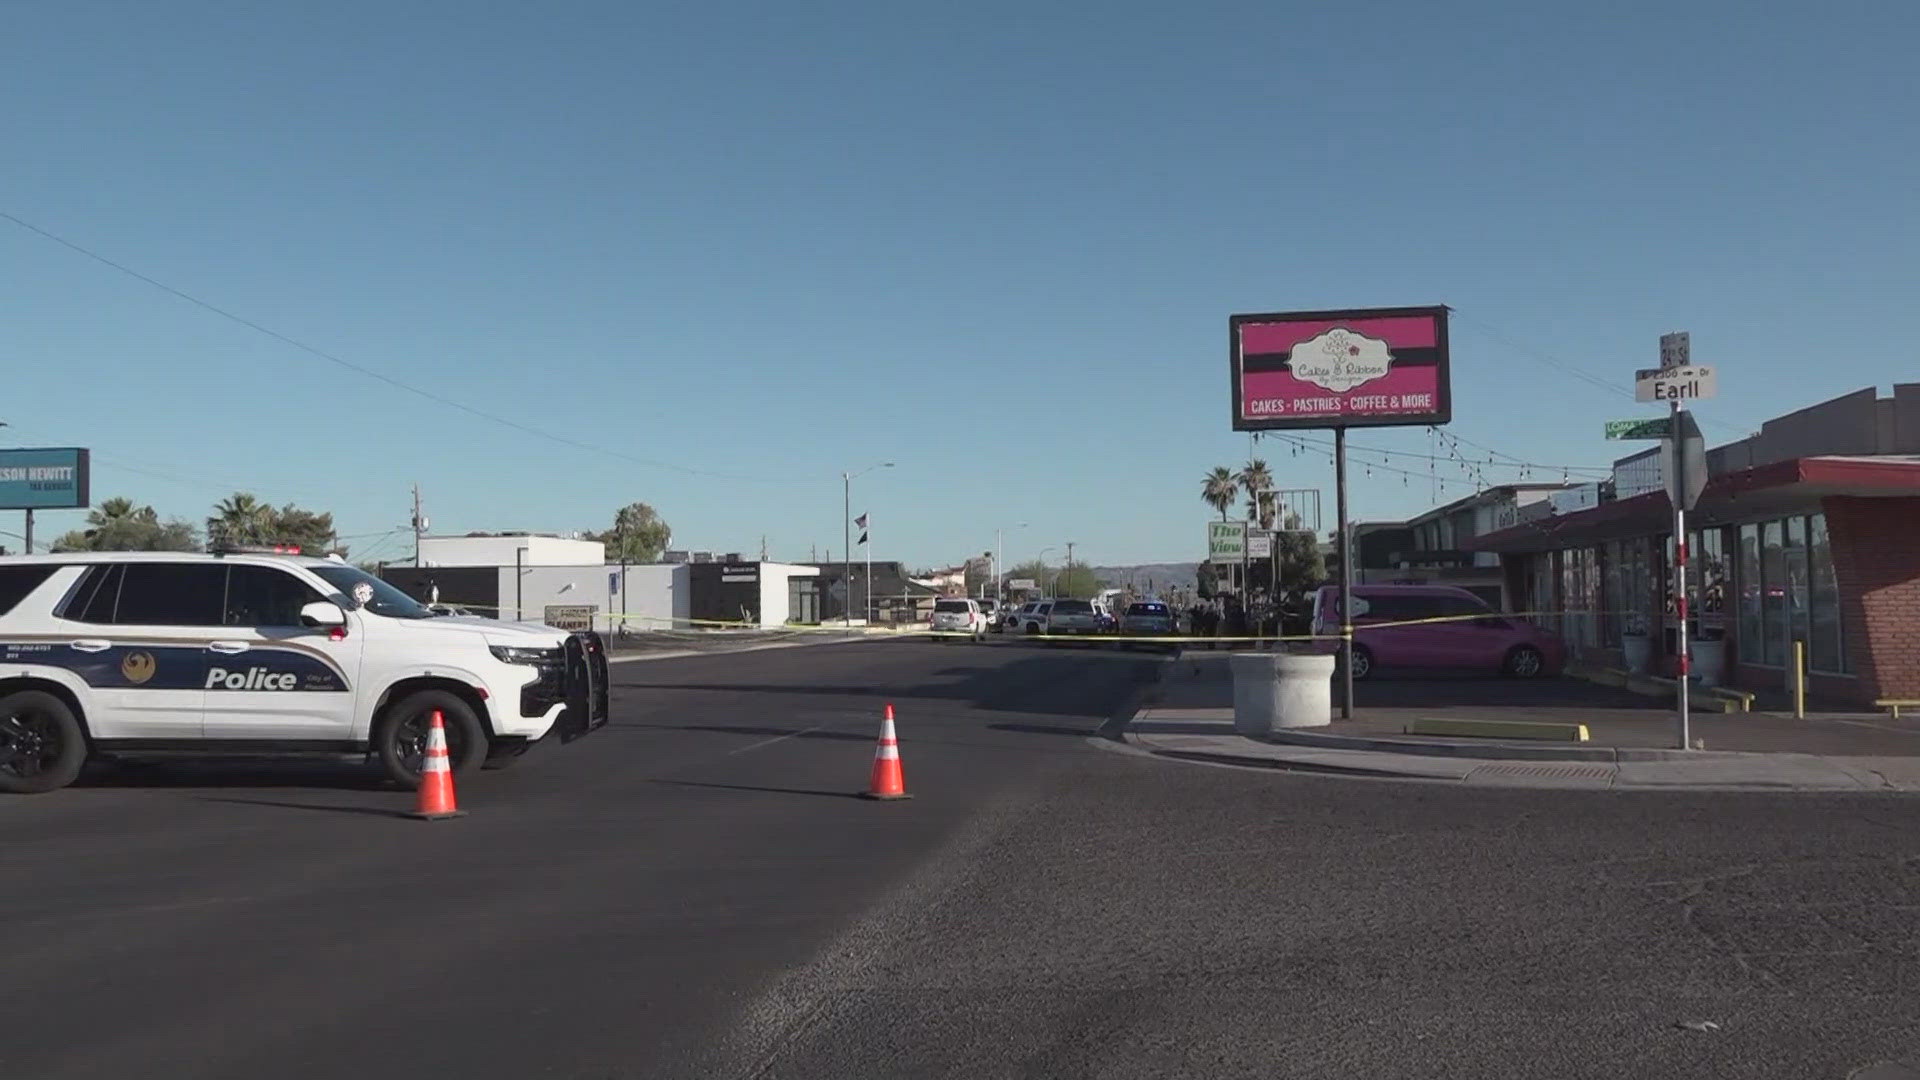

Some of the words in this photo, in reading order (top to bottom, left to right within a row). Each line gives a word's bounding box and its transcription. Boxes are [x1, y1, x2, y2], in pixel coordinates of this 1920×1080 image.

[1298, 363, 1330, 378] Cakes
[1346, 361, 1384, 376] Ribbon
[1655, 380, 1699, 400] Earll
[1251, 399, 1285, 413] CAKES
[1293, 397, 1341, 411] PASTRIES
[1350, 396, 1387, 410] COFFEE
[1391, 395, 1400, 408] &
[1401, 394, 1432, 408] MORE
[29, 466, 73, 481] HEWITT
[1212, 524, 1241, 538] The
[1211, 540, 1242, 553] View
[205, 666, 297, 690] Police
